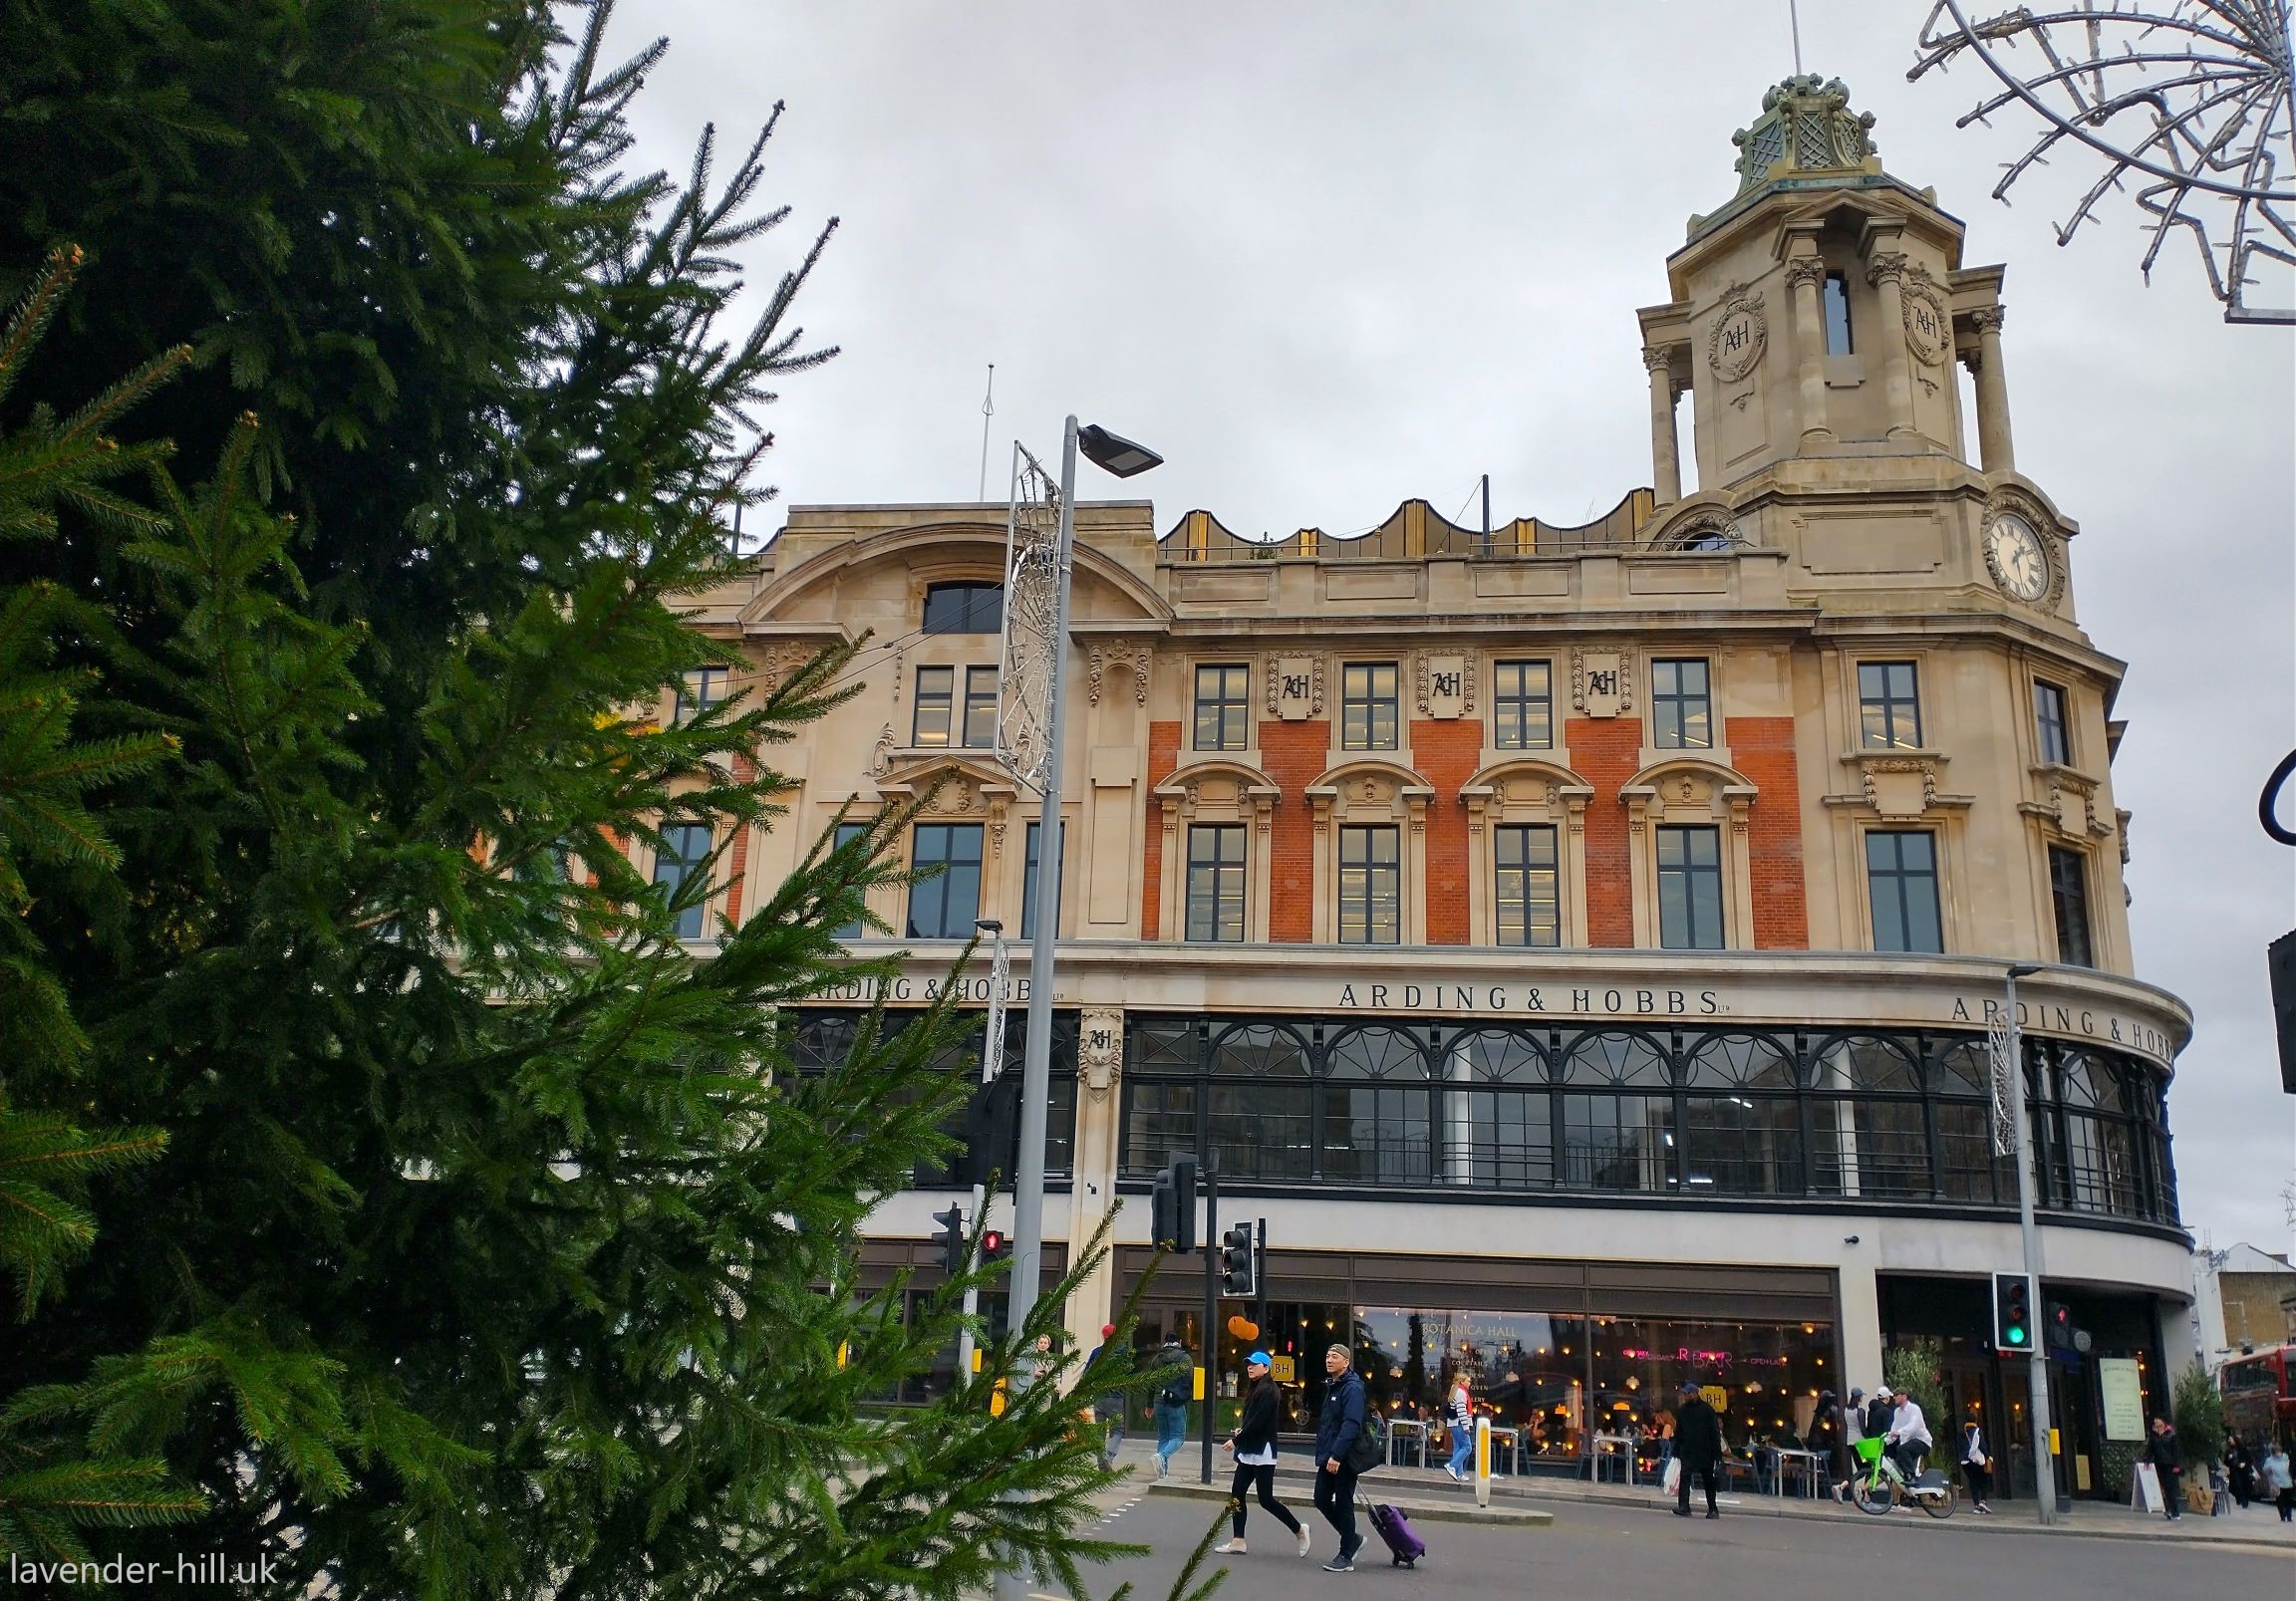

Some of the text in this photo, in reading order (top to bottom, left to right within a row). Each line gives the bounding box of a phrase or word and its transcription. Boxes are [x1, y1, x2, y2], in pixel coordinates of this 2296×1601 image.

[924, 978, 939, 1000] &
[954, 978, 1031, 1001] HOB
[1338, 983, 1507, 1009] ARDING
[1527, 987, 1546, 1011] &
[1572, 989, 1716, 1014] HOBBS
[1951, 997, 2094, 1034] ARDING
[2111, 1017, 2123, 1042] &
[1422, 1323, 1516, 1337] BOTANICA HALL
[1275, 1363, 1290, 1374] BH
[1706, 1394, 1722, 1405] BH
